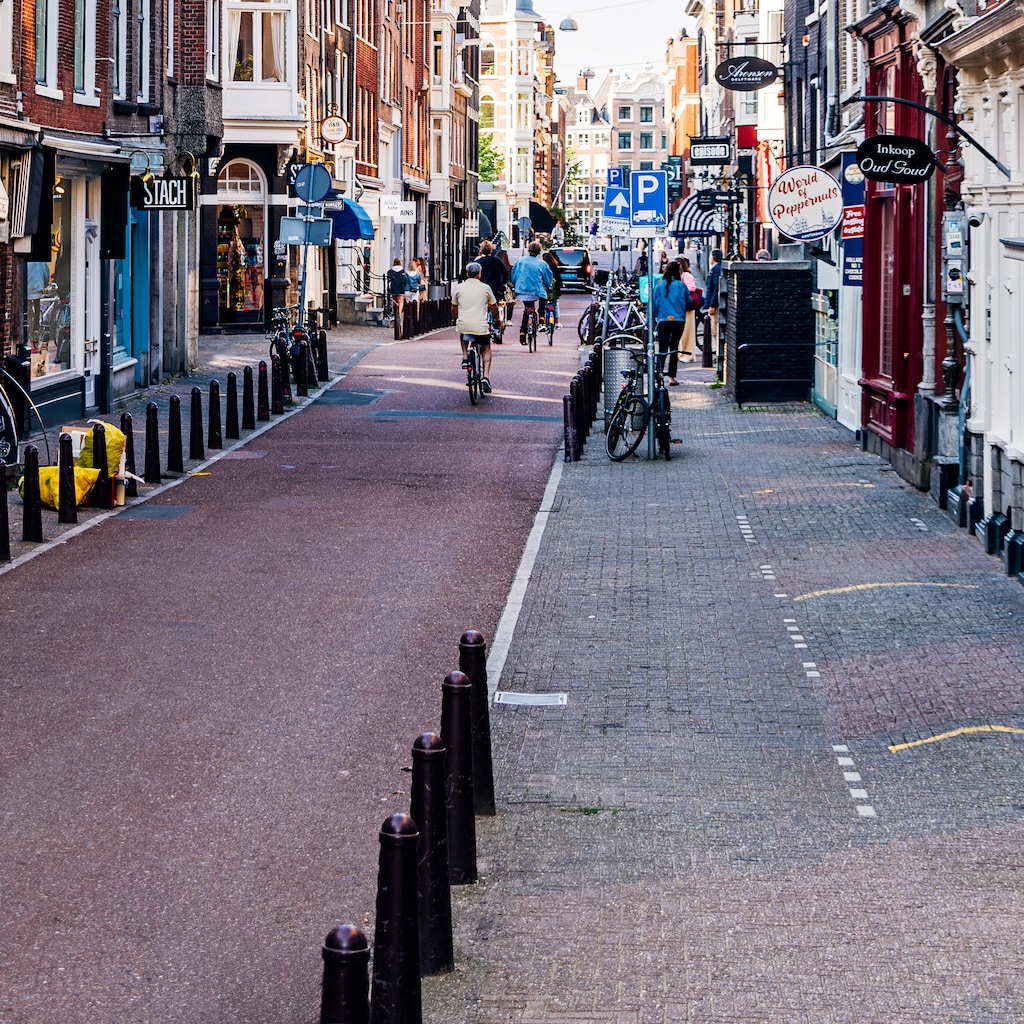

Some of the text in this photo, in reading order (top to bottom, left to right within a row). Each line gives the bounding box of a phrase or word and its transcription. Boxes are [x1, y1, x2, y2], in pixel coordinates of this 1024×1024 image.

[719, 61, 774, 81] Aronson
[694, 146, 726, 157] episode
[877, 143, 916, 158] Inkoop
[610, 169, 619, 182] P
[860, 157, 893, 174] Oud
[891, 160, 932, 176] Goud
[144, 179, 187, 205] STACH
[637, 175, 660, 204] P
[778, 172, 818, 194] World
[797, 187, 808, 198] of
[772, 187, 838, 219] Peppernuts
